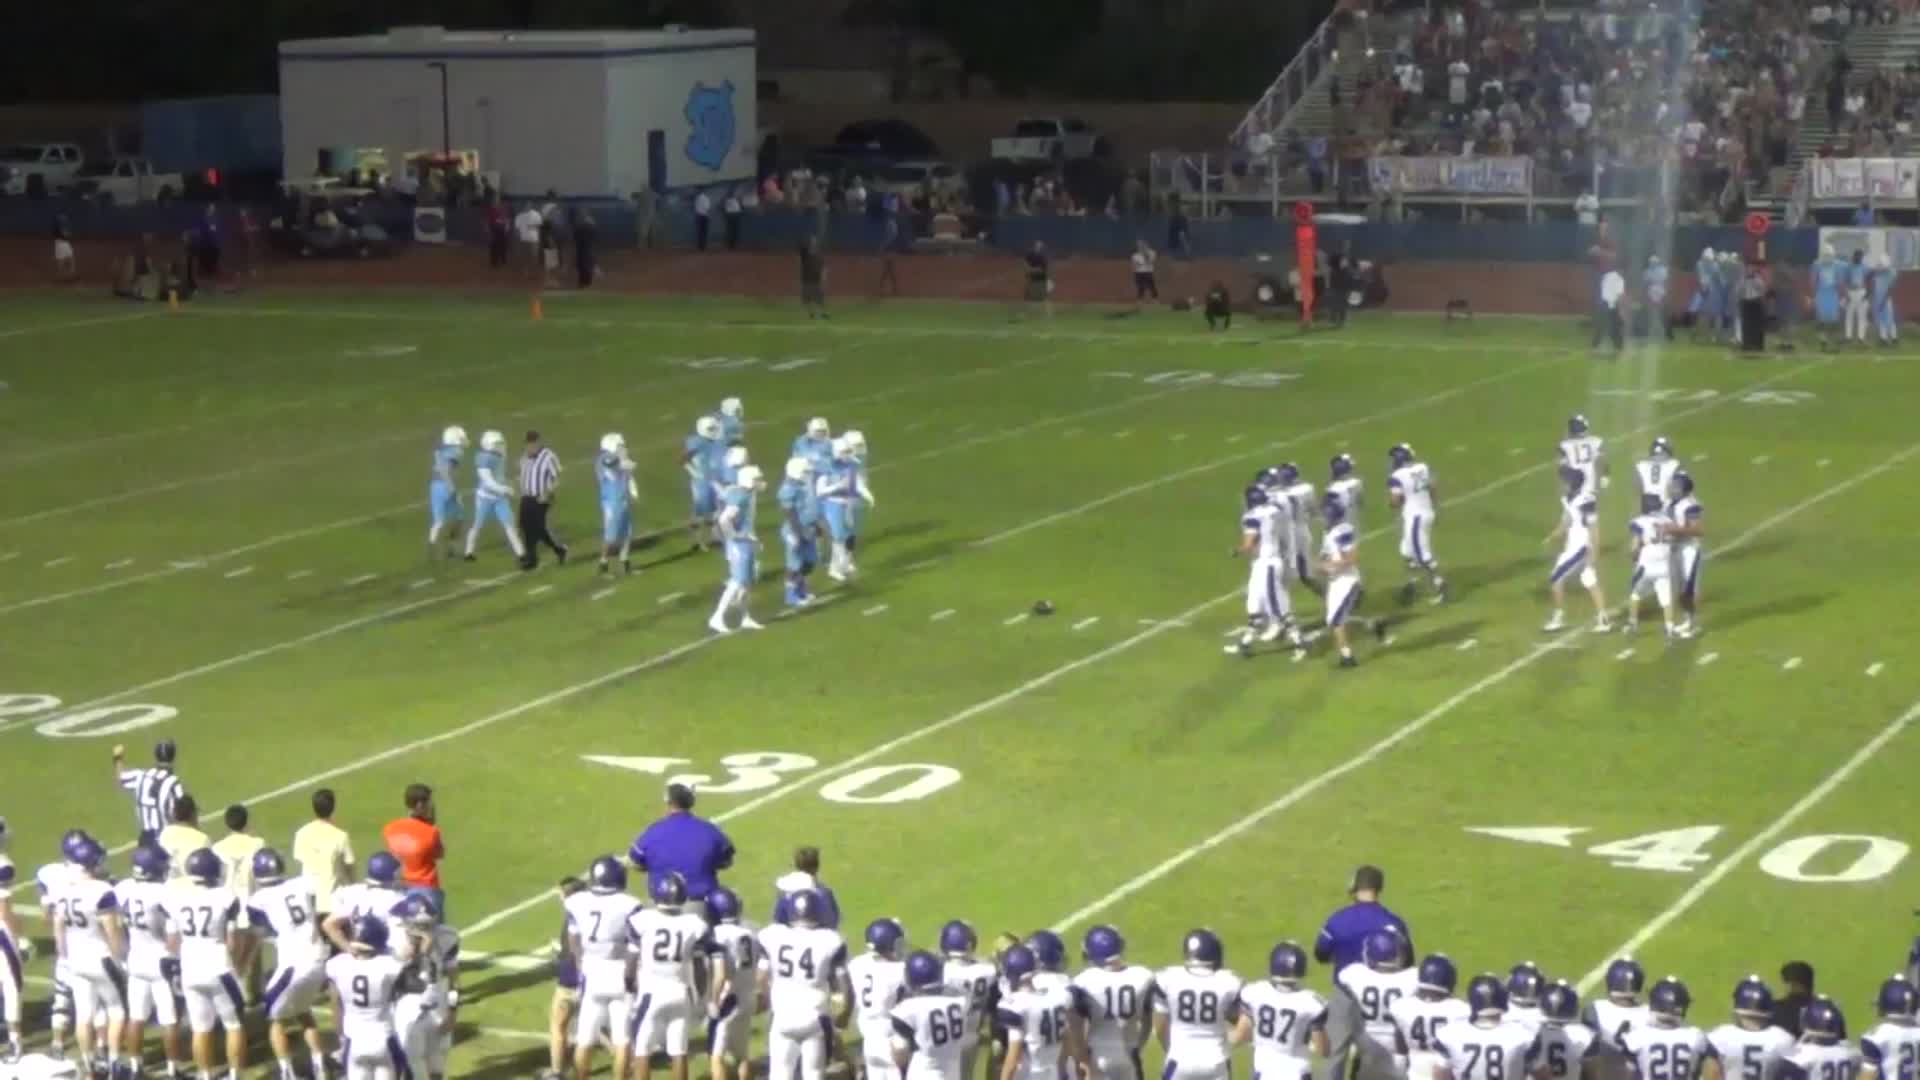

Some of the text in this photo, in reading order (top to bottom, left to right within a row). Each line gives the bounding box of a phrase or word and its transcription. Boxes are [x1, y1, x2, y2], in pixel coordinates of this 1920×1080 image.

[666, 751, 962, 803] 30
[1587, 824, 1911, 882] 40
[58, 898, 88, 928] 35
[180, 906, 213, 937] 37
[285, 894, 306, 927] 6
[589, 911, 602, 943] 7
[652, 928, 684, 963] 21
[777, 945, 816, 980] 54
[351, 974, 369, 1008] 9
[1105, 984, 1136, 1020] 10
[1178, 990, 1218, 1024] 88
[929, 1003, 963, 1046] 66
[1258, 1004, 1297, 1044] 87
[1461, 1043, 1504, 1080] 78
[1649, 1043, 1691, 1080] 26
[1742, 1044, 1764, 1080] 5
